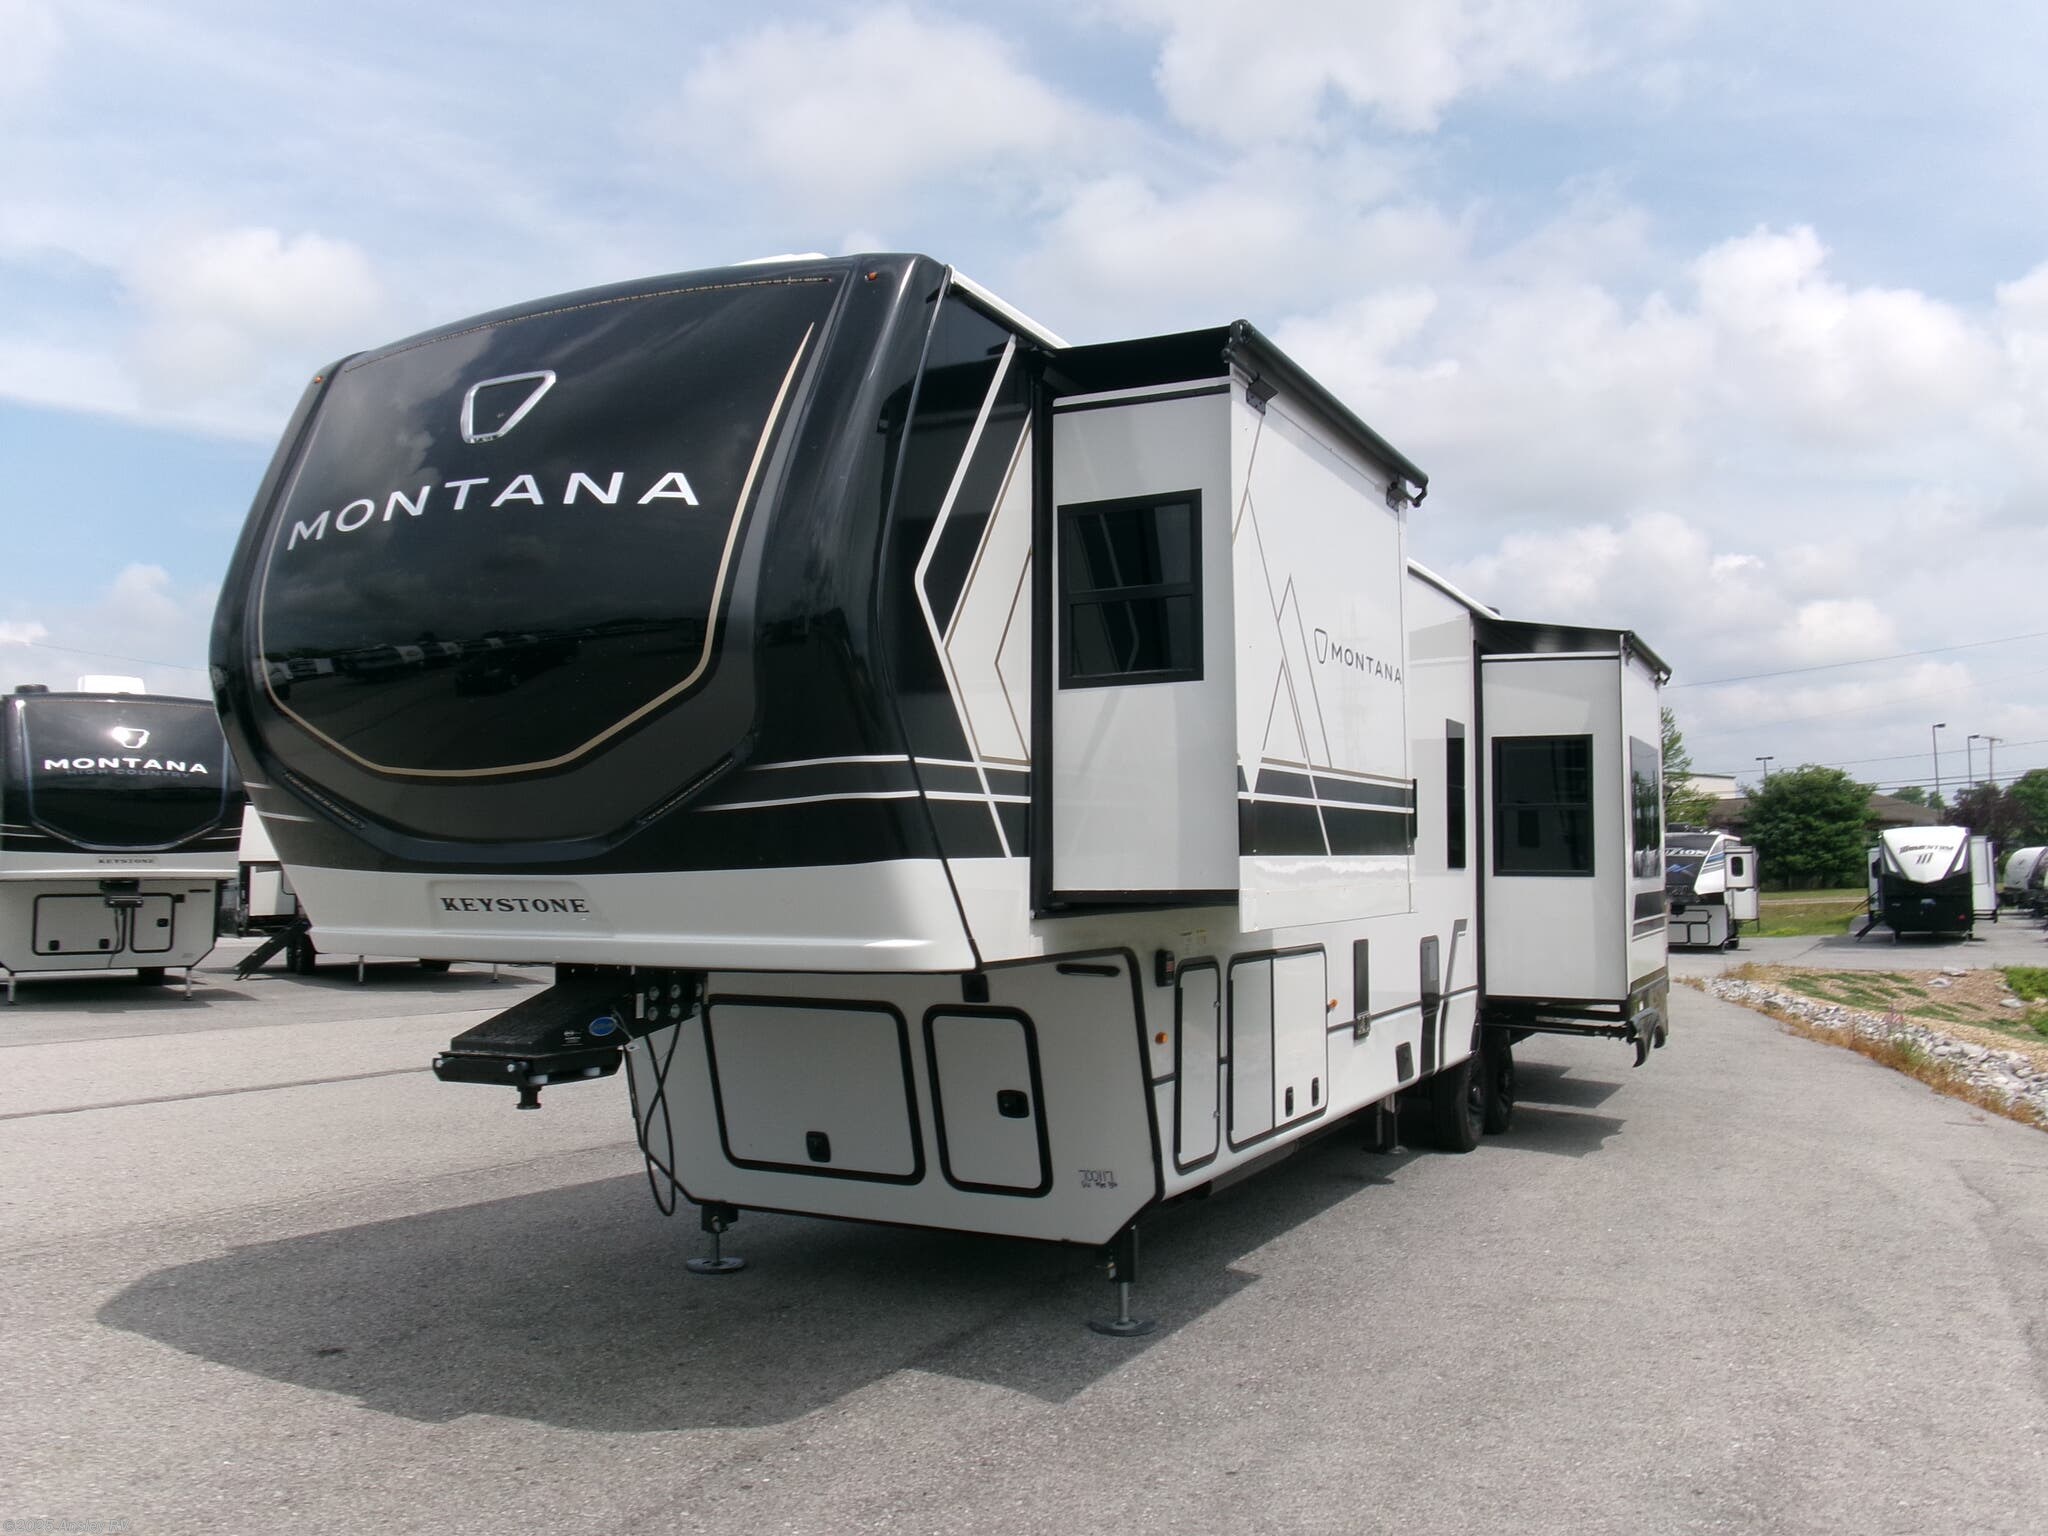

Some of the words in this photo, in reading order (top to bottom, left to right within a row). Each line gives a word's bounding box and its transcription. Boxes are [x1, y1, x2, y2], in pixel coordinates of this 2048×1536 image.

[287, 471, 699, 550] MONTANA
[1331, 641, 1402, 684] MONTANA
[44, 757, 208, 774] MONTANA
[114, 768, 191, 778] COUNTRY
[440, 897, 590, 913] KEYSTONE
